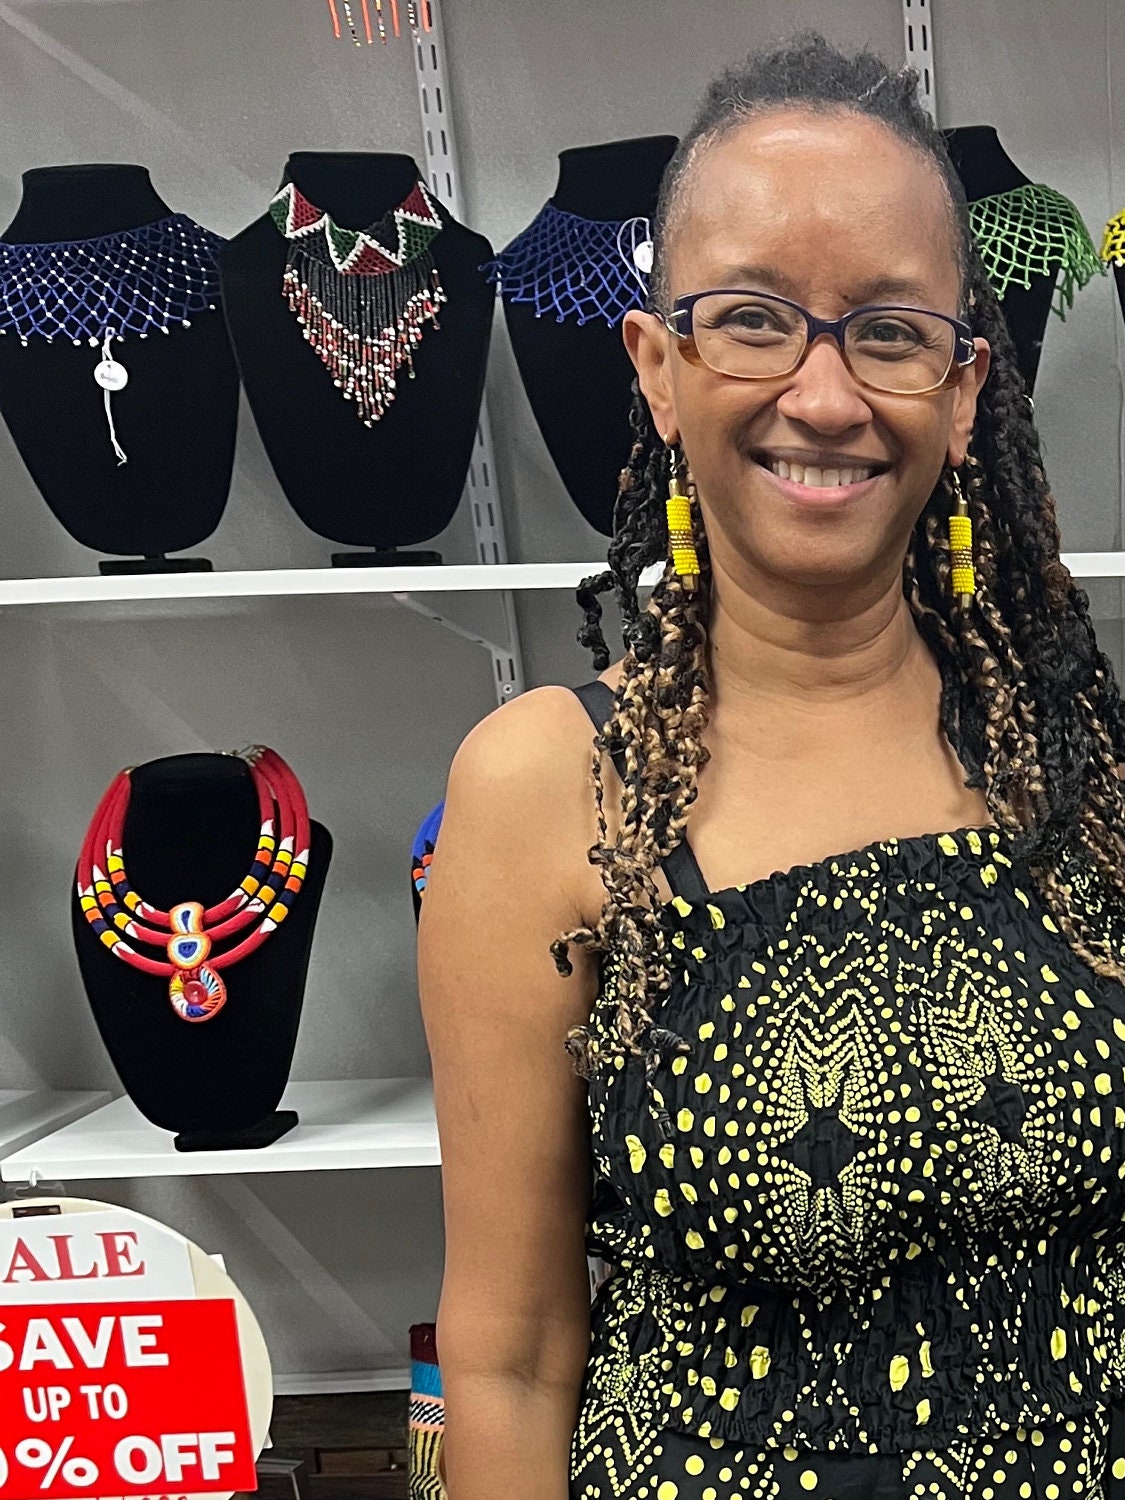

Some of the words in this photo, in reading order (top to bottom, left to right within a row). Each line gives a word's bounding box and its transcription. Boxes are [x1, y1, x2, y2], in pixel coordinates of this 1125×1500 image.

[22, 1386, 71, 1422] UP
[79, 1383, 128, 1420] TO
[113, 1431, 236, 1485] OFF
